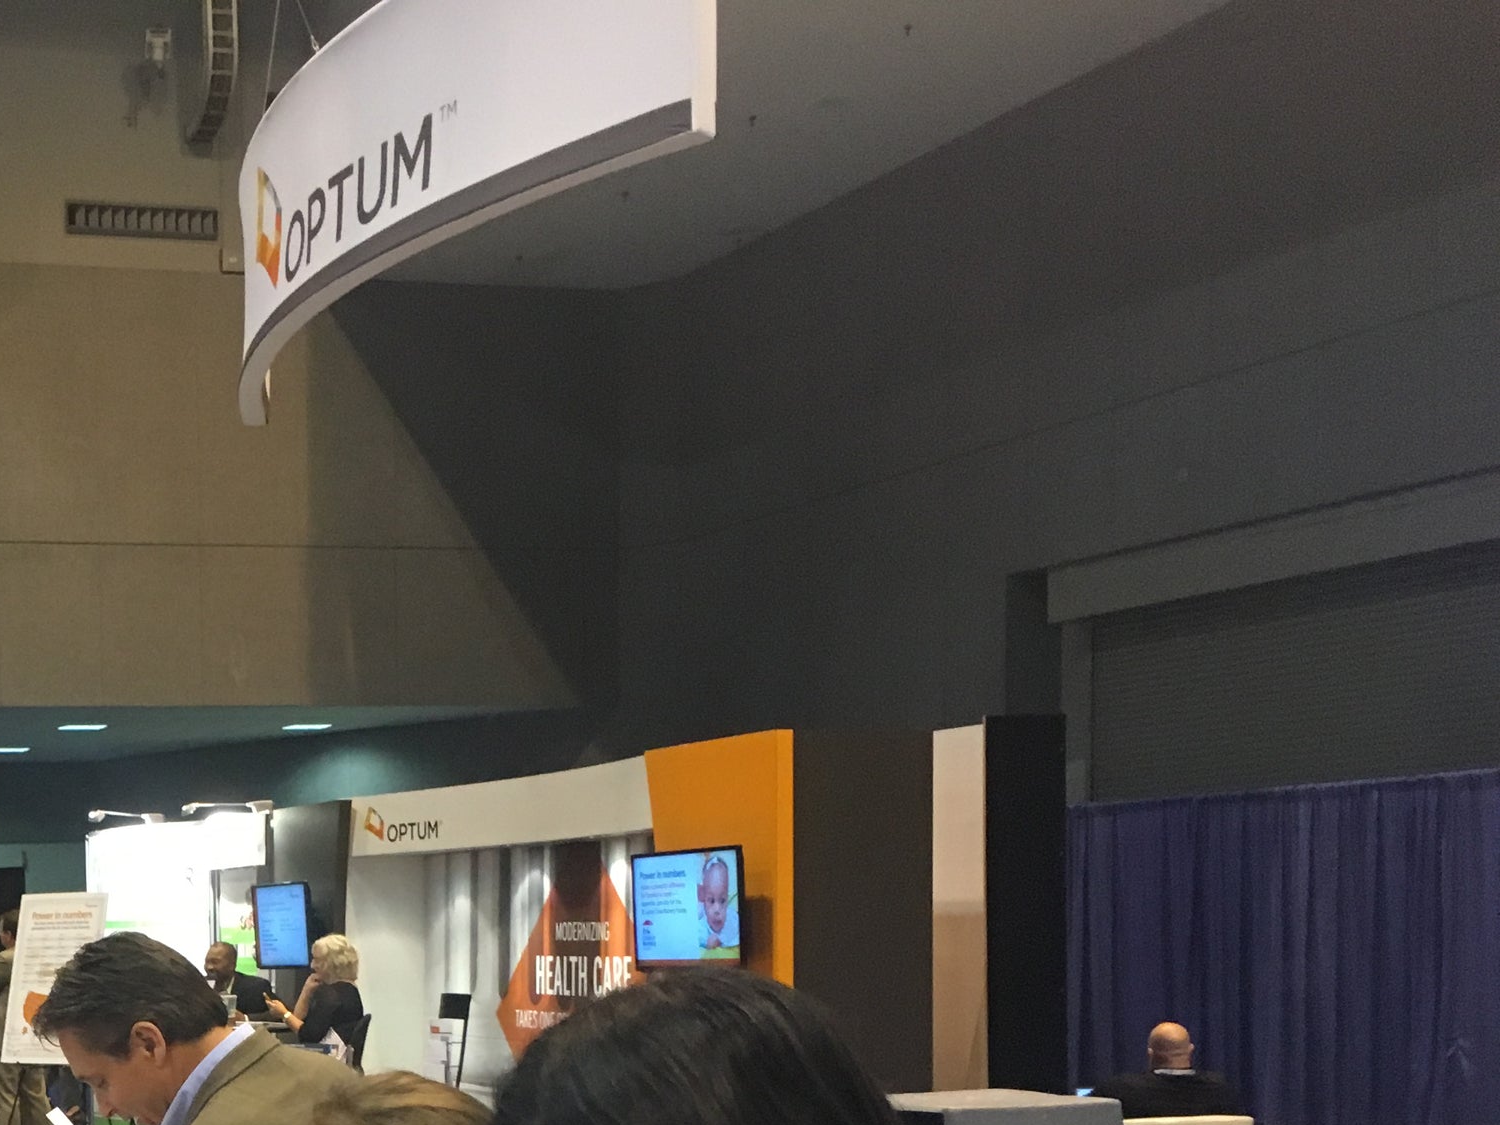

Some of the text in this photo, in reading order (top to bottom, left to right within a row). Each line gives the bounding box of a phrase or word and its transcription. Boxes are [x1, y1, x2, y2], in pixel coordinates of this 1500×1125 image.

[284, 112, 433, 283] OPTUM
[387, 820, 439, 843] OPTUM
[555, 920, 610, 941] MODERNIZING
[535, 954, 588, 998] HEALTH
[515, 1008, 539, 1029] TAKES
